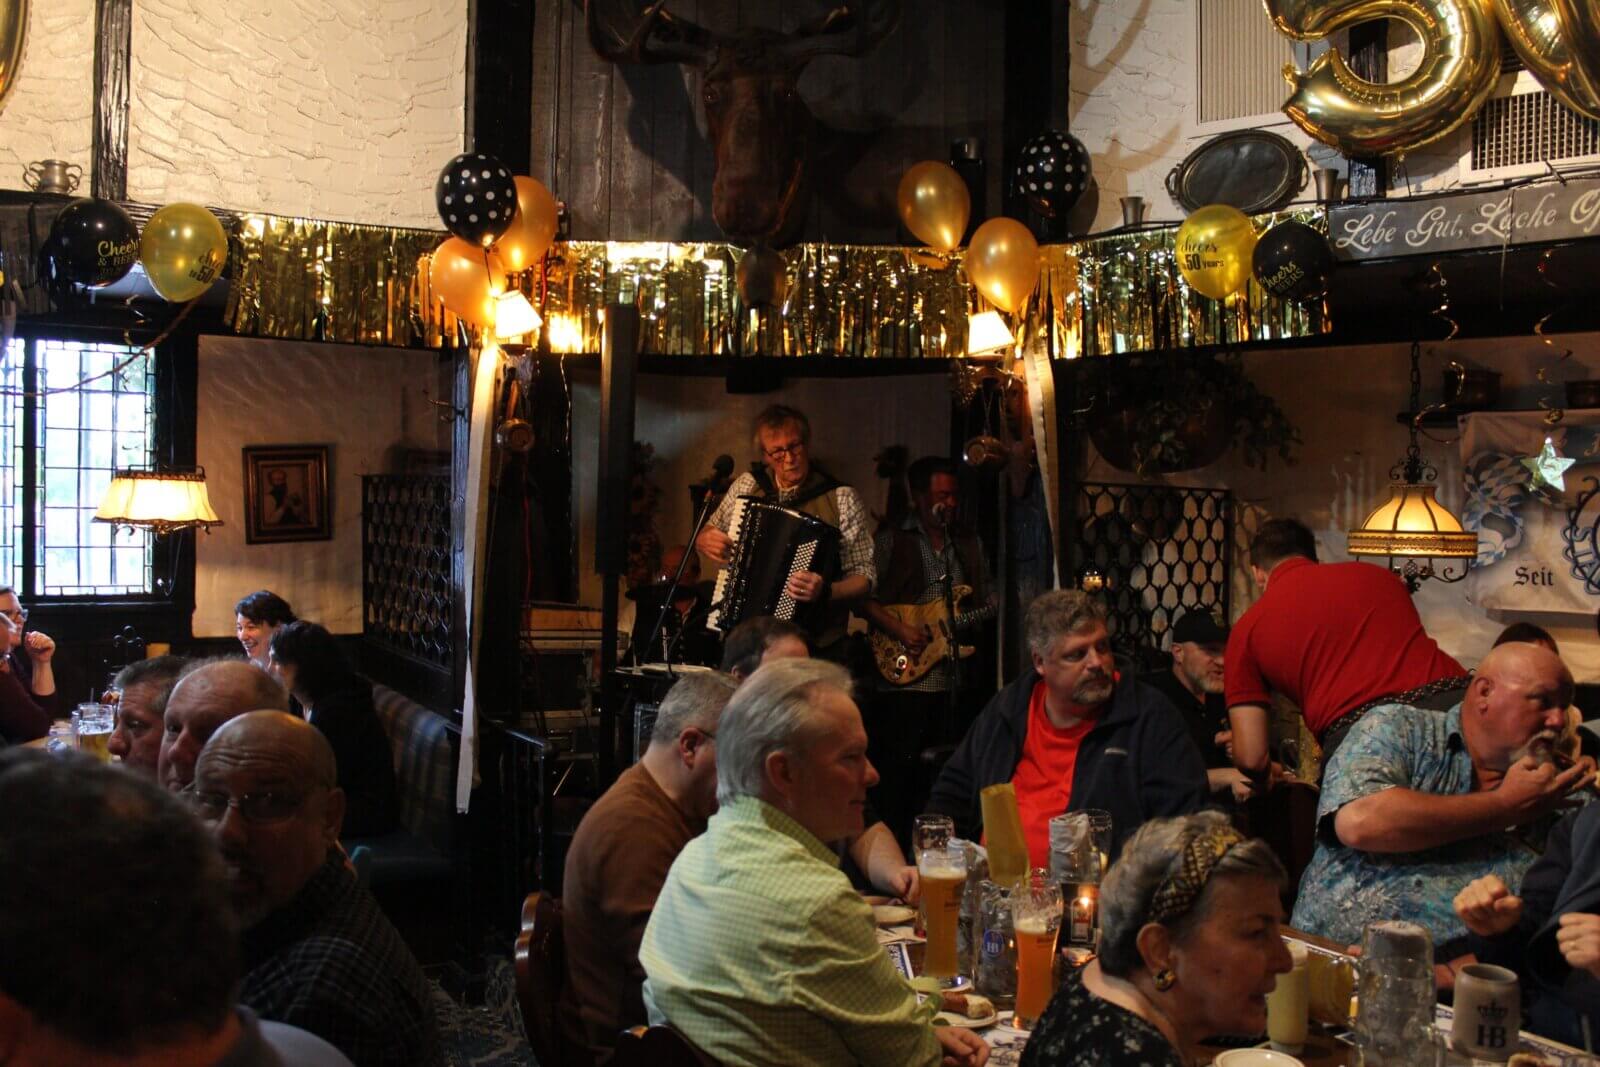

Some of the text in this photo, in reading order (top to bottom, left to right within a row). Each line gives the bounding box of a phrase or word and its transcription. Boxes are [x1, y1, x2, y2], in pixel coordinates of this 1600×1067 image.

[1336, 210, 1397, 253] Lebe
[1405, 206, 1463, 247] Gut,
[1471, 193, 1556, 240] Lache
[1185, 253, 1201, 270] 50
[1513, 565, 1554, 587] Seit
[1477, 1024, 1506, 1048] HB
